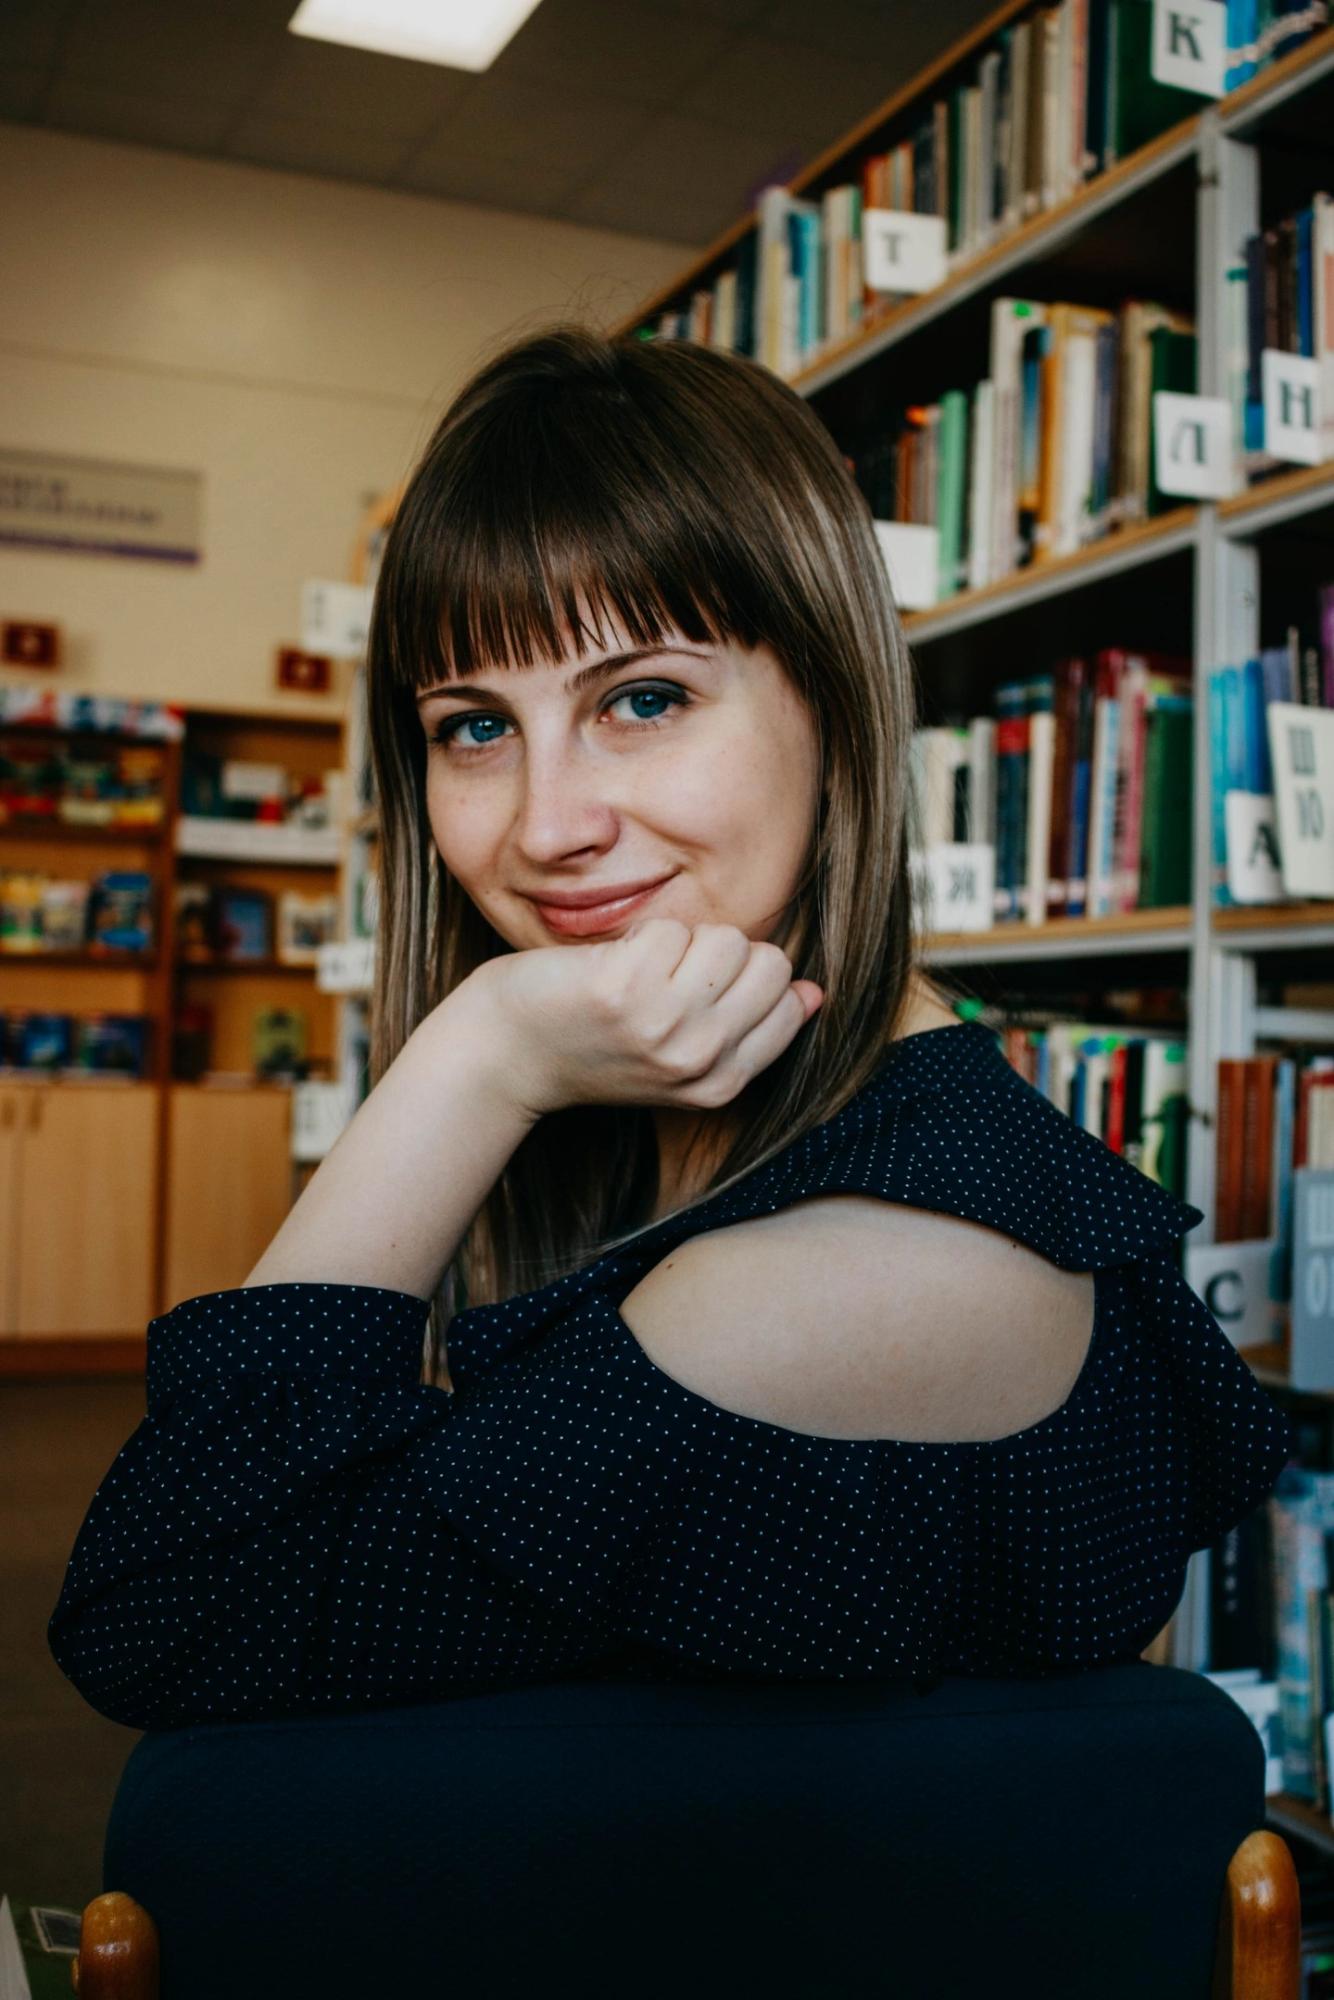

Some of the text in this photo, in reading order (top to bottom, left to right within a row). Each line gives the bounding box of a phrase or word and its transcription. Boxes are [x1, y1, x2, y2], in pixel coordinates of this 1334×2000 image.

[1167, 11, 1203, 62] К
[880, 231, 909, 267] Т
[1278, 377, 1314, 430] Н
[1169, 418, 1206, 465] Л
[1248, 820, 1282, 874] А
[1204, 1268, 1247, 1323] С
